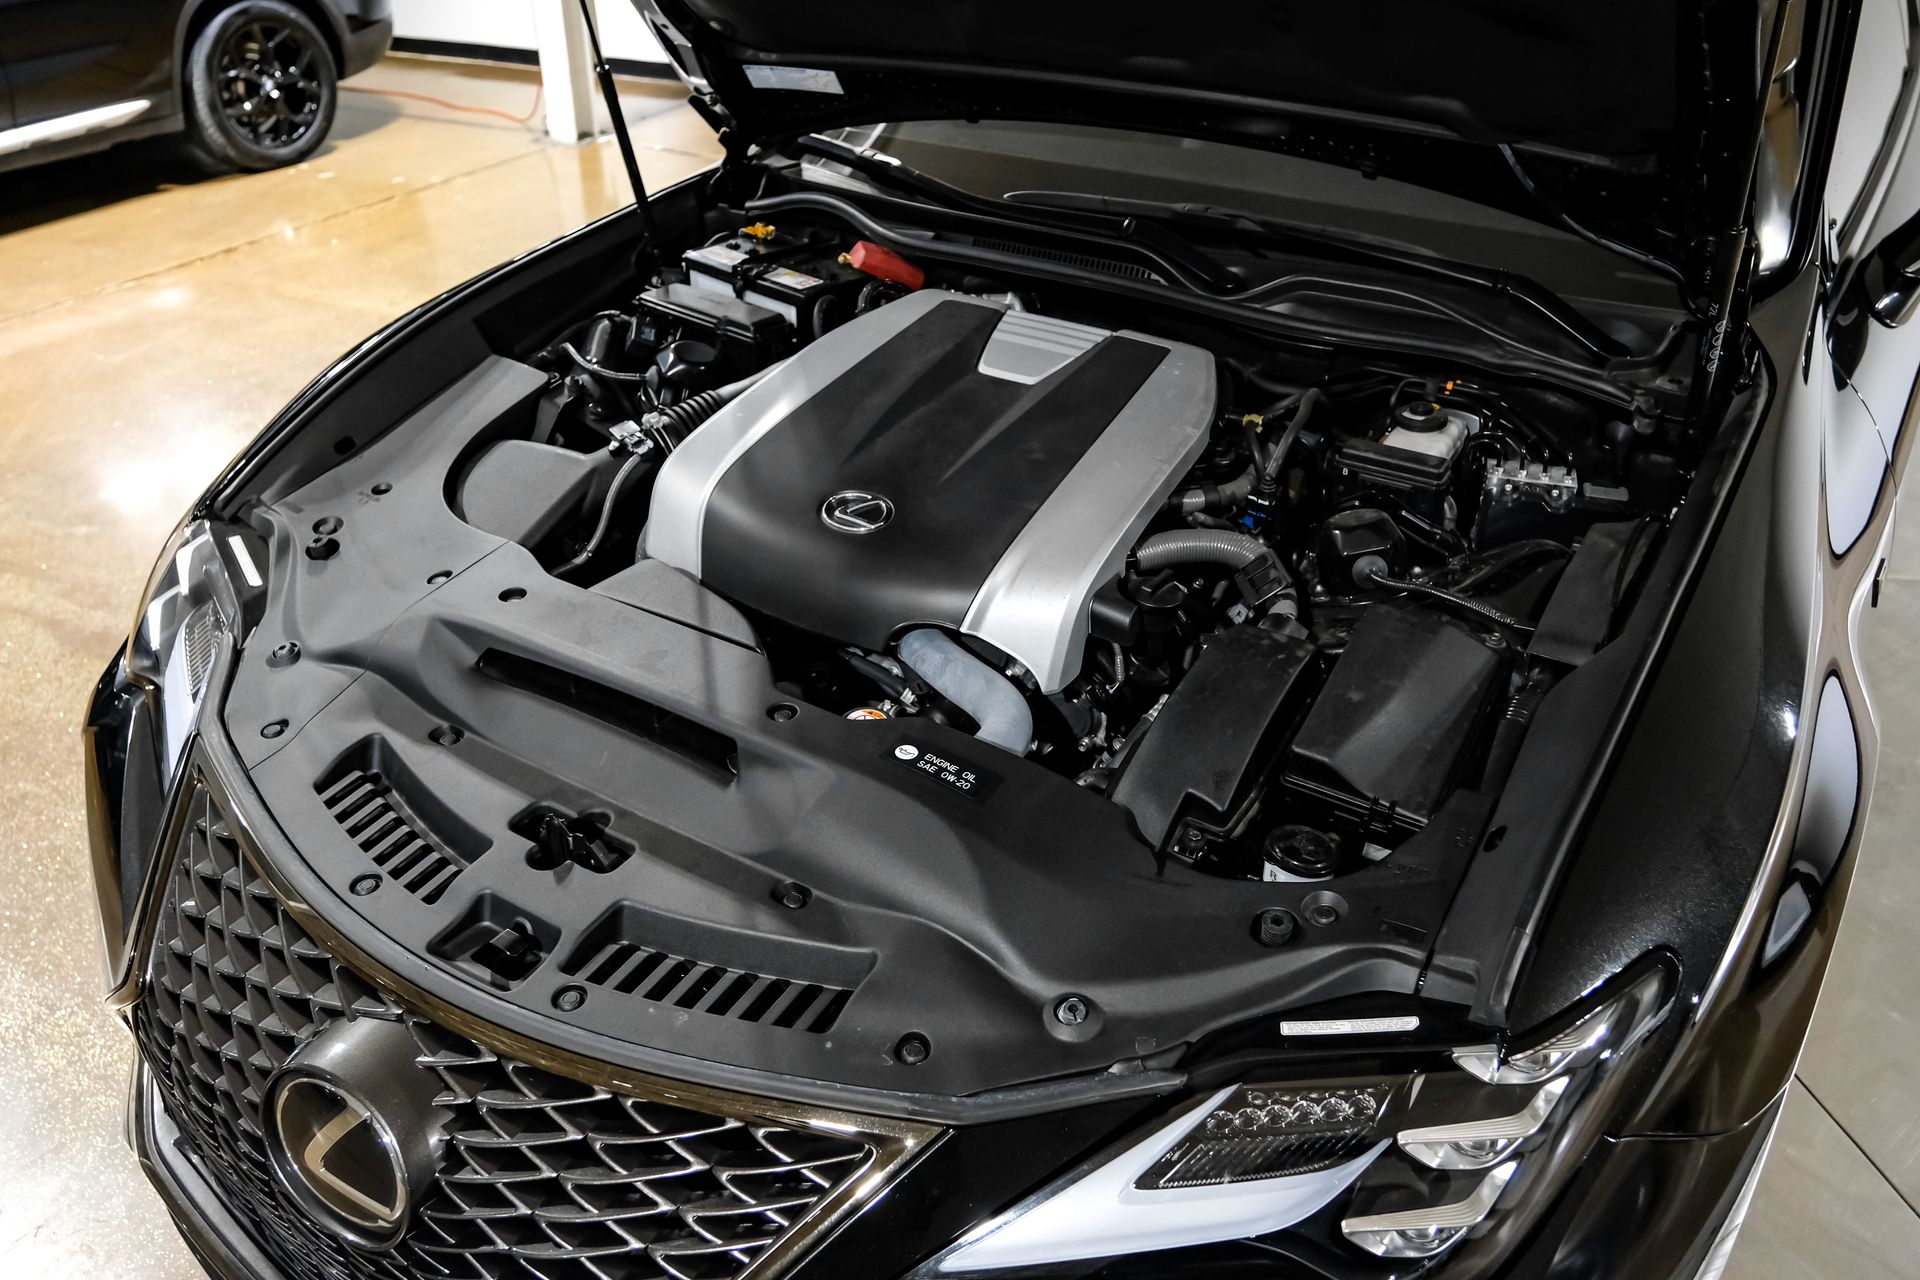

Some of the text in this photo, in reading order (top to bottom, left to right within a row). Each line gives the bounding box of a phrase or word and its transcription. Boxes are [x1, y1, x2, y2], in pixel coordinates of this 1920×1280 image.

[917, 760, 971, 790] SAE 0W-20
[924, 753, 976, 783] ENGINE OIL
